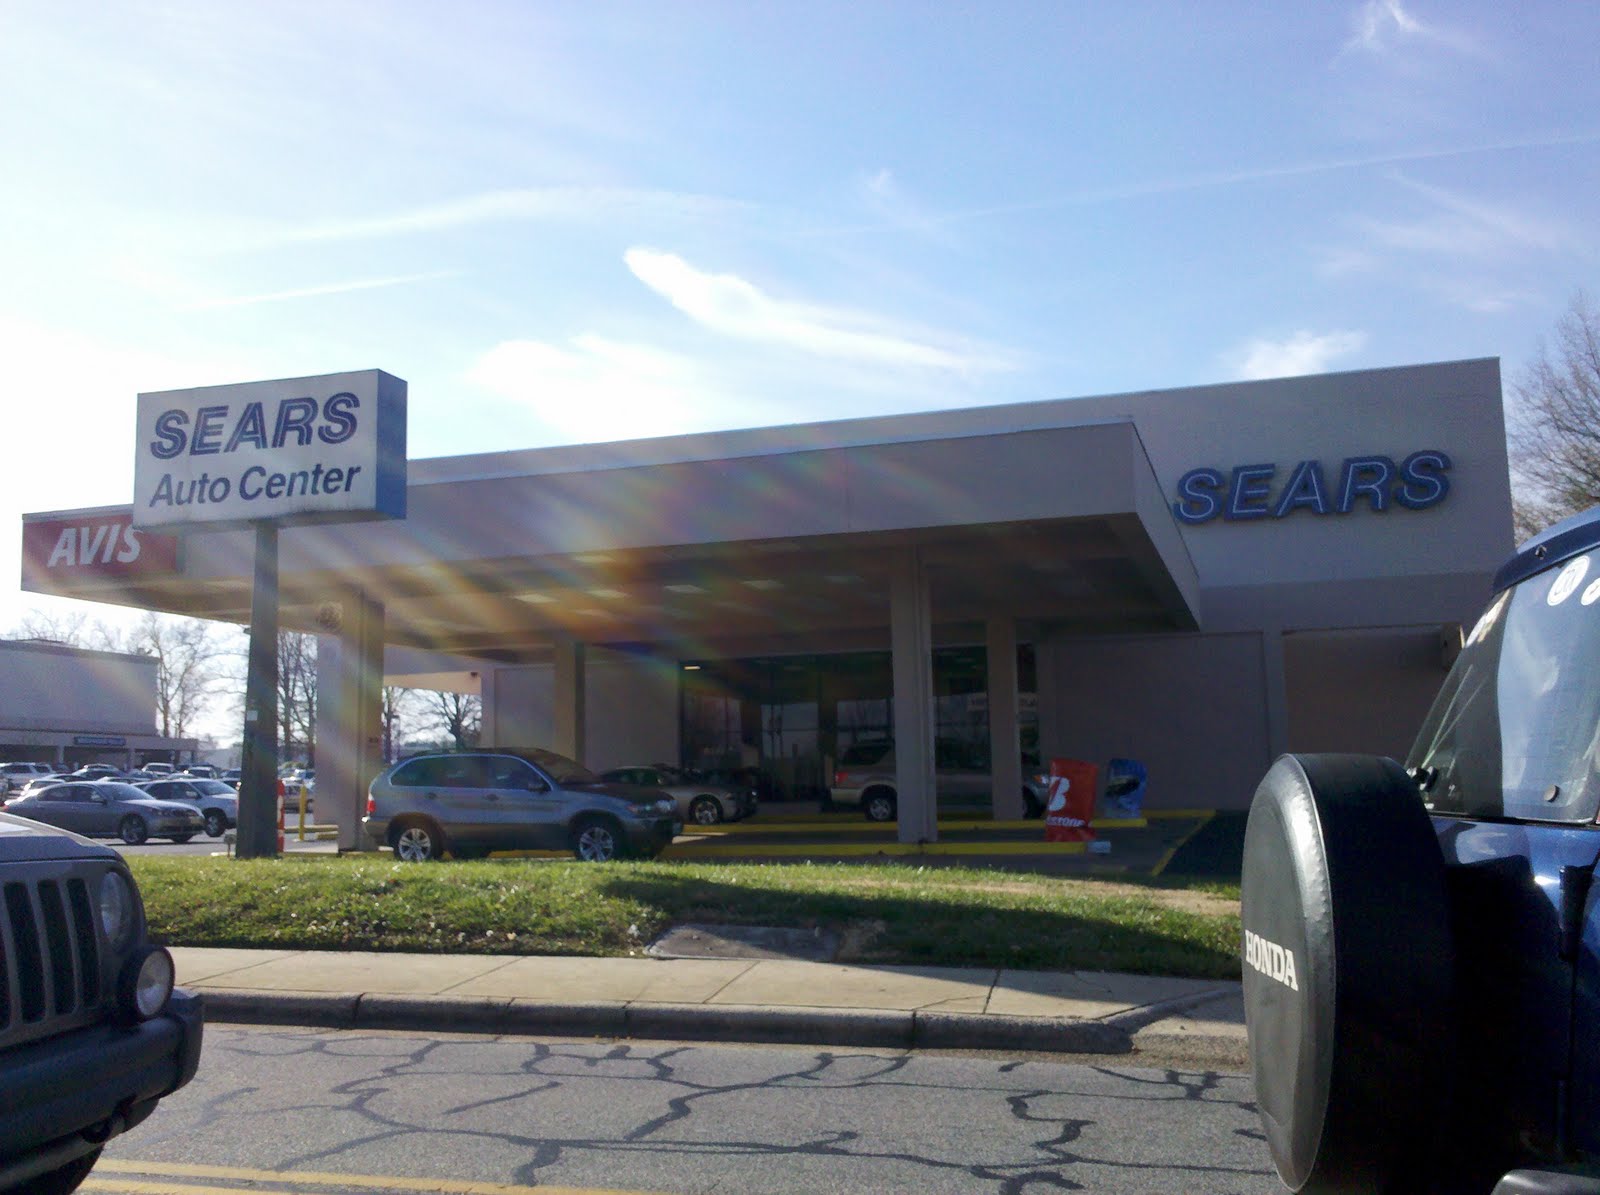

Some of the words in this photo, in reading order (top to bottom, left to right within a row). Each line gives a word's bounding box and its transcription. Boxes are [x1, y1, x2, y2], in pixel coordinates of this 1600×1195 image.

[150, 391, 361, 460] SEARS
[149, 473, 231, 508] Auto
[239, 464, 362, 501] Center
[1172, 449, 1452, 525] SEARS
[47, 523, 144, 568] AVIS
[1244, 929, 1299, 992] HONDA
